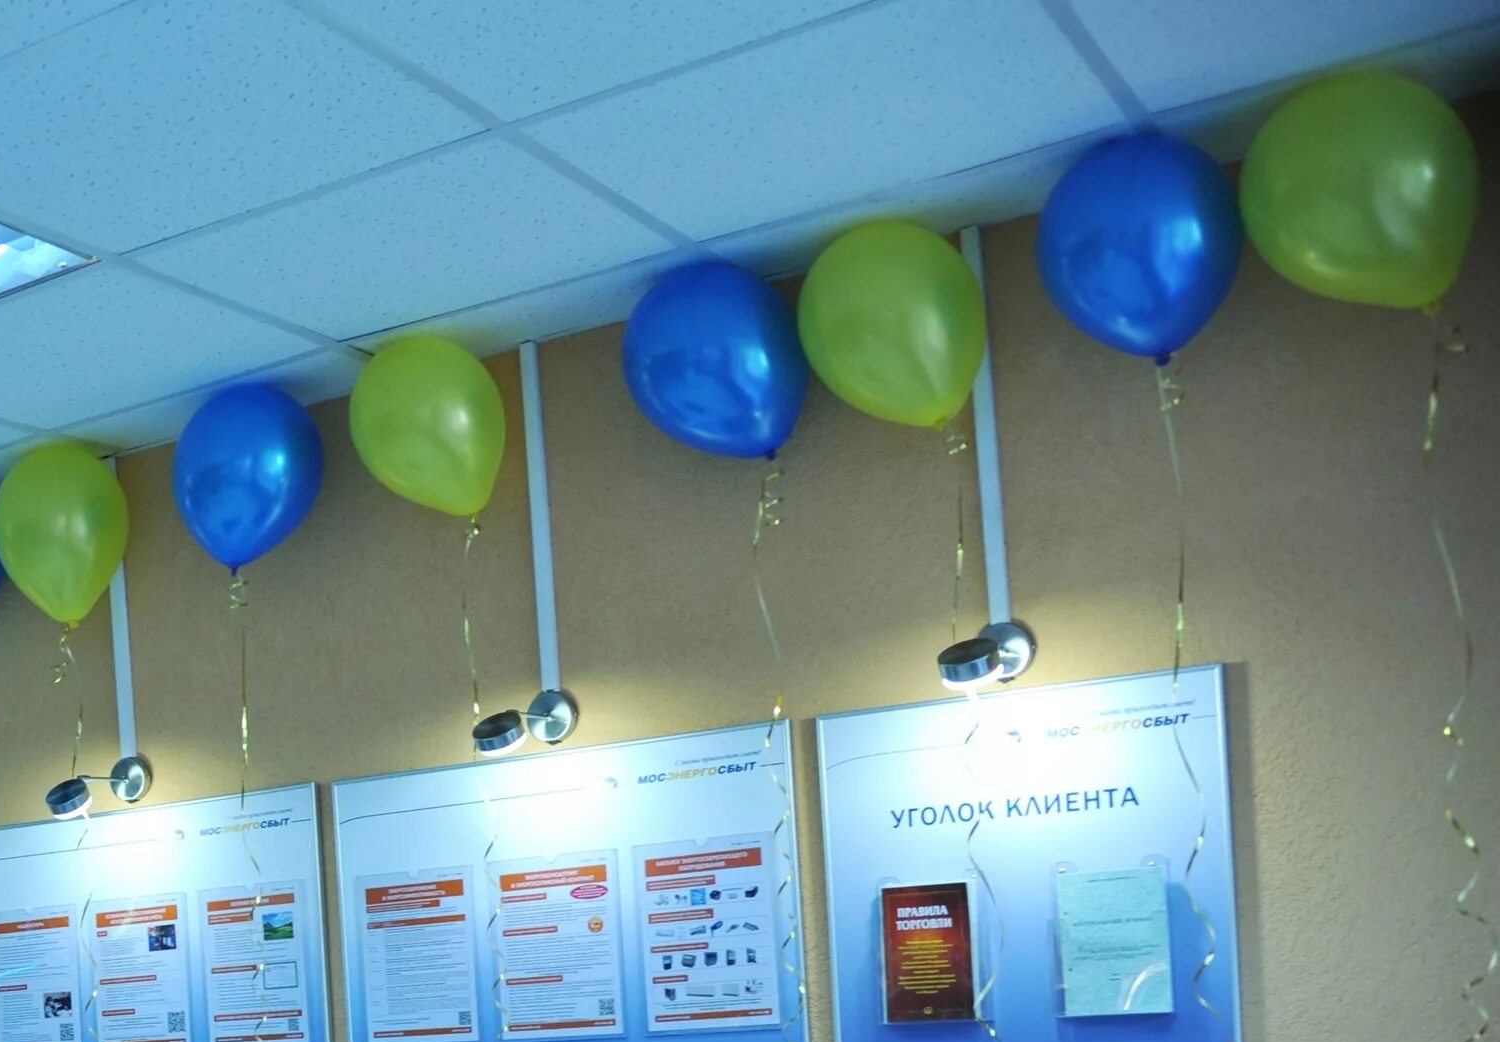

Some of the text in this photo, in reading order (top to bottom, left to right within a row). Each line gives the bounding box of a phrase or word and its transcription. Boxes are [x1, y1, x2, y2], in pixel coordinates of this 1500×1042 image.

[891, 786, 1140, 829] УГОЛОК КЛИЕНТА
[896, 905, 949, 919] ПРАВИЛА
[895, 917, 953, 931] ТОРГОВЛИ
